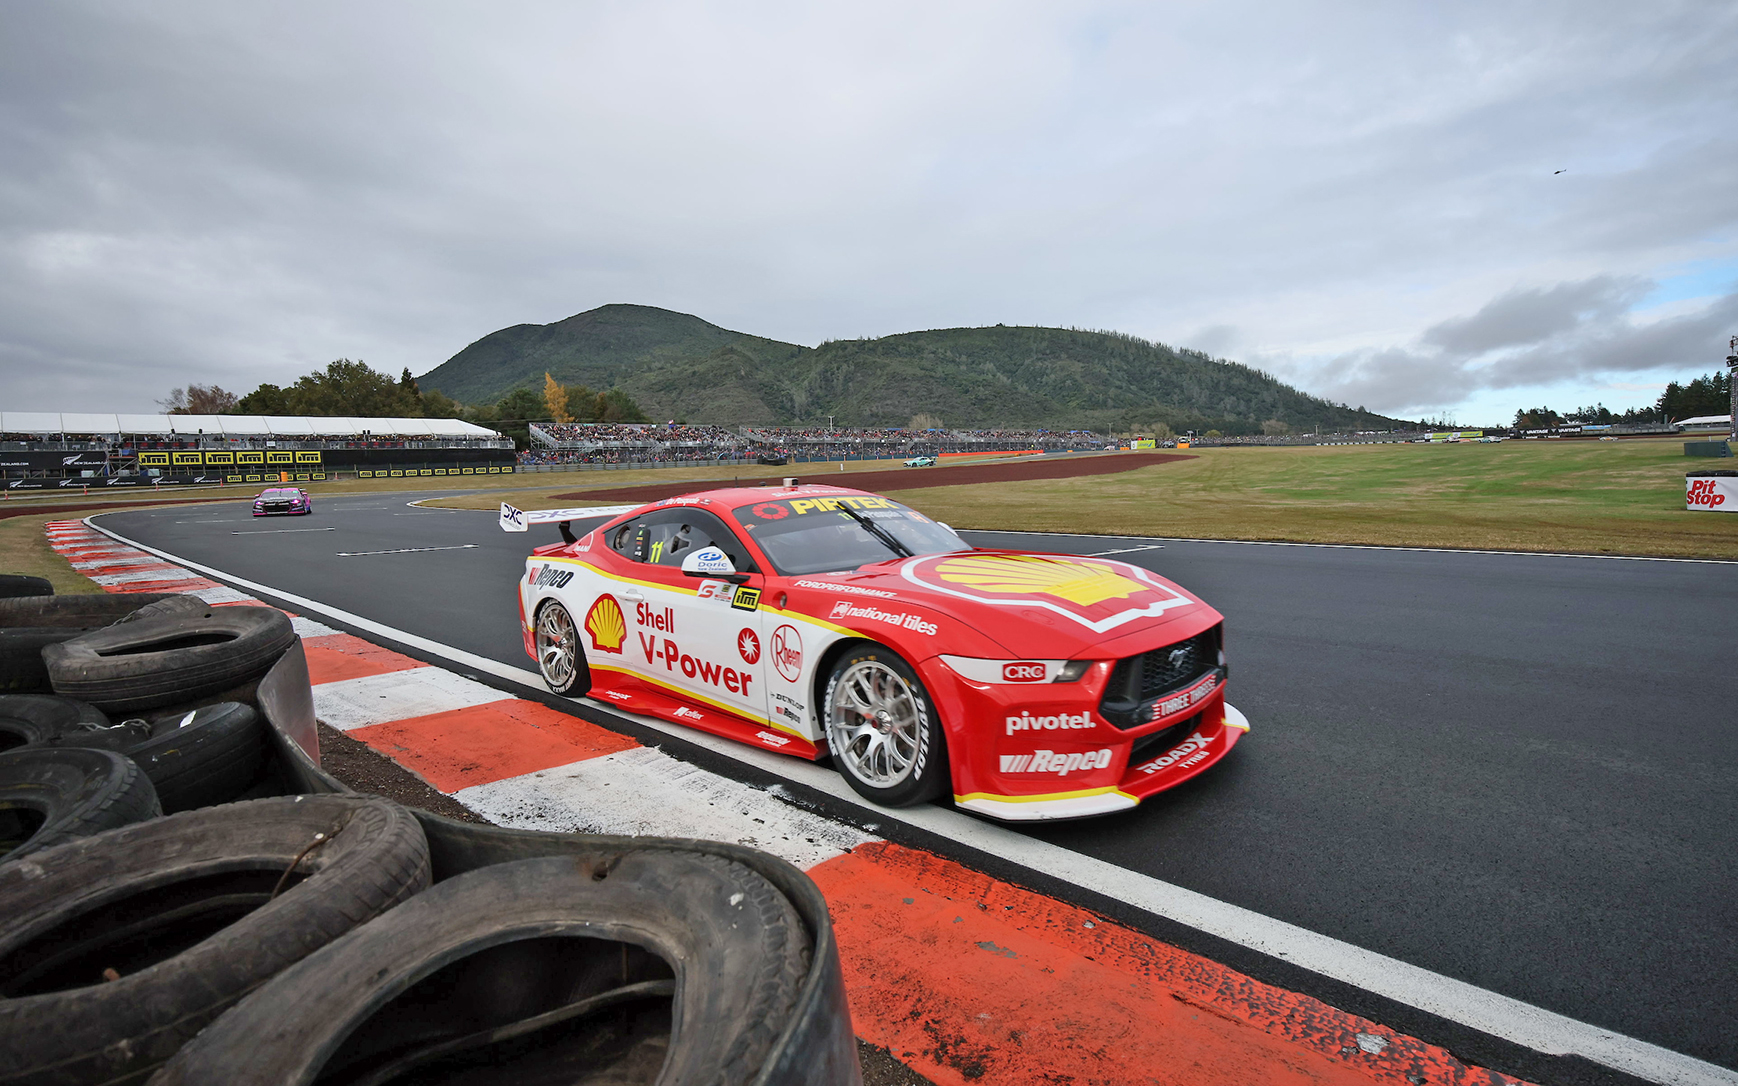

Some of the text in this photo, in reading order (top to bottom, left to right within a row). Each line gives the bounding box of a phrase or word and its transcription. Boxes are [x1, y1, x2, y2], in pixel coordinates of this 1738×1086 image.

[1687, 490, 1725, 508] Stop
[1692, 480, 1716, 495] Pit
[788, 496, 900, 515] PIRTEK
[650, 541, 664, 563] 11
[534, 563, 574, 590] Repco
[637, 602, 674, 634] Shell
[846, 606, 938, 636] national tiles
[775, 626, 801, 672] Rheem
[638, 631, 753, 697] V-Power
[1004, 666, 1044, 679] CRC
[776, 693, 805, 711] DUNLOP
[1160, 693, 1191, 716] THREE
[784, 707, 801, 724] Repco
[914, 697, 930, 781] DUNLOP
[1027, 749, 1113, 776] Repco
[1136, 732, 1216, 774] ROADX
[1178, 750, 1211, 768] TYRES
